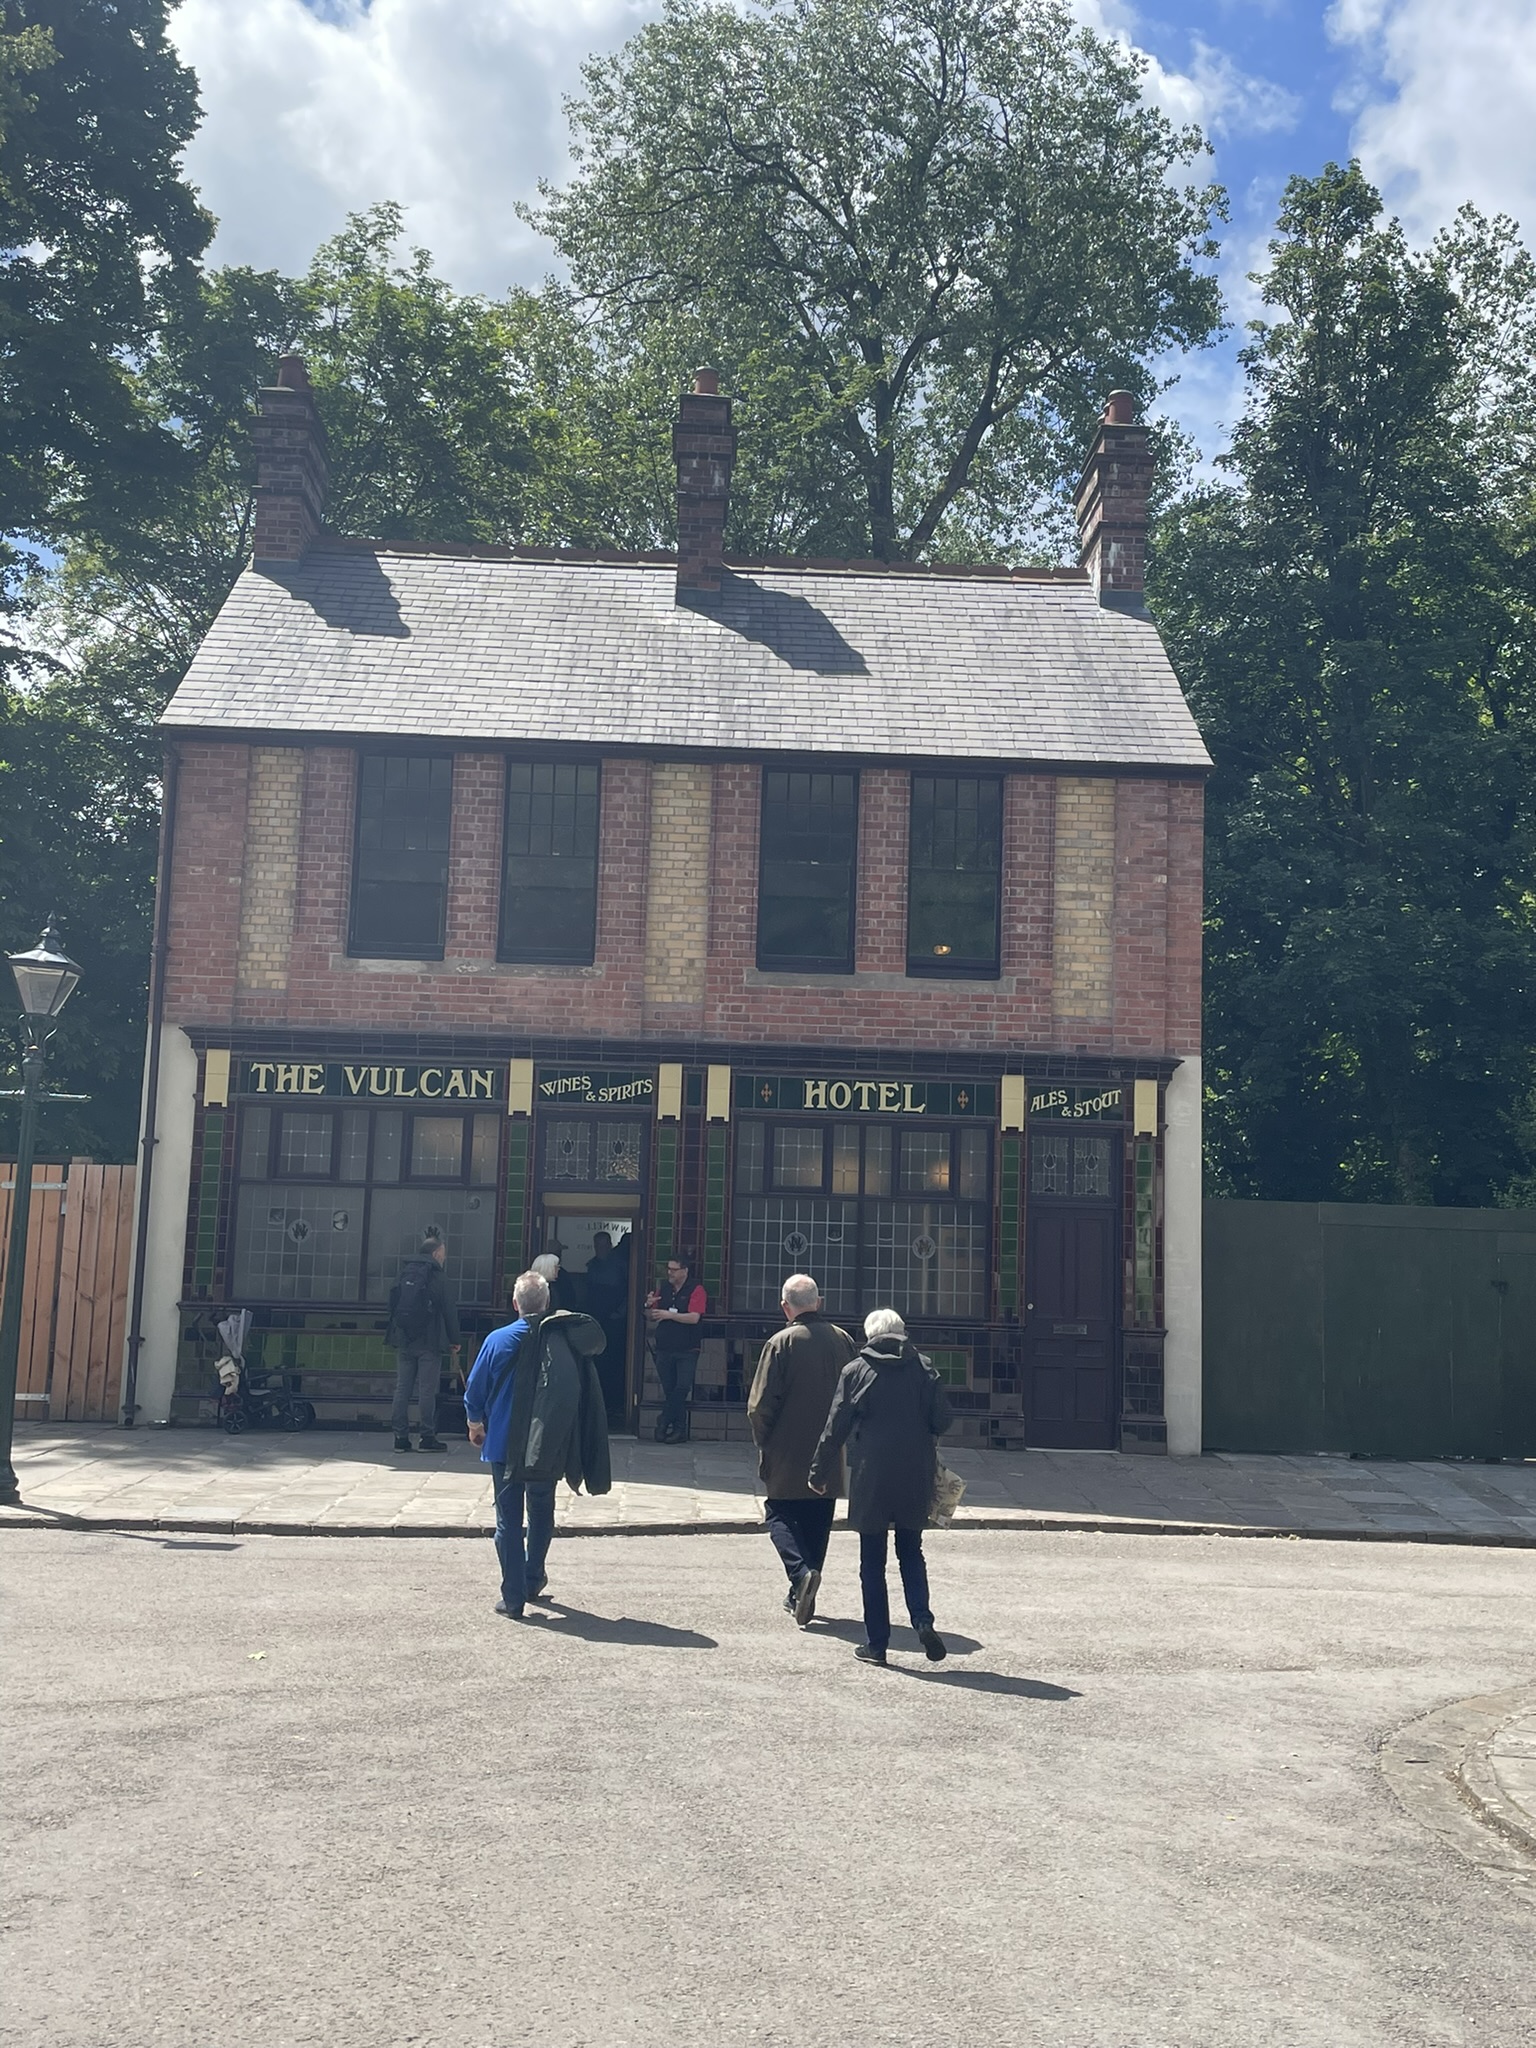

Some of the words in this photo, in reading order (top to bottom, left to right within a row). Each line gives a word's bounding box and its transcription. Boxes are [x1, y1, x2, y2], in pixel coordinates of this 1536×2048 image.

[251, 1063, 325, 1095] THE
[344, 1066, 493, 1099] VULCAN
[539, 1075, 591, 1096] WINES
[586, 1091, 596, 1102] &
[598, 1079, 653, 1102] SPIRITS
[804, 1080, 926, 1113] HOTEL
[1030, 1089, 1067, 1112] ALES
[1061, 1106, 1072, 1117] &
[1073, 1089, 1122, 1117] STOUT
